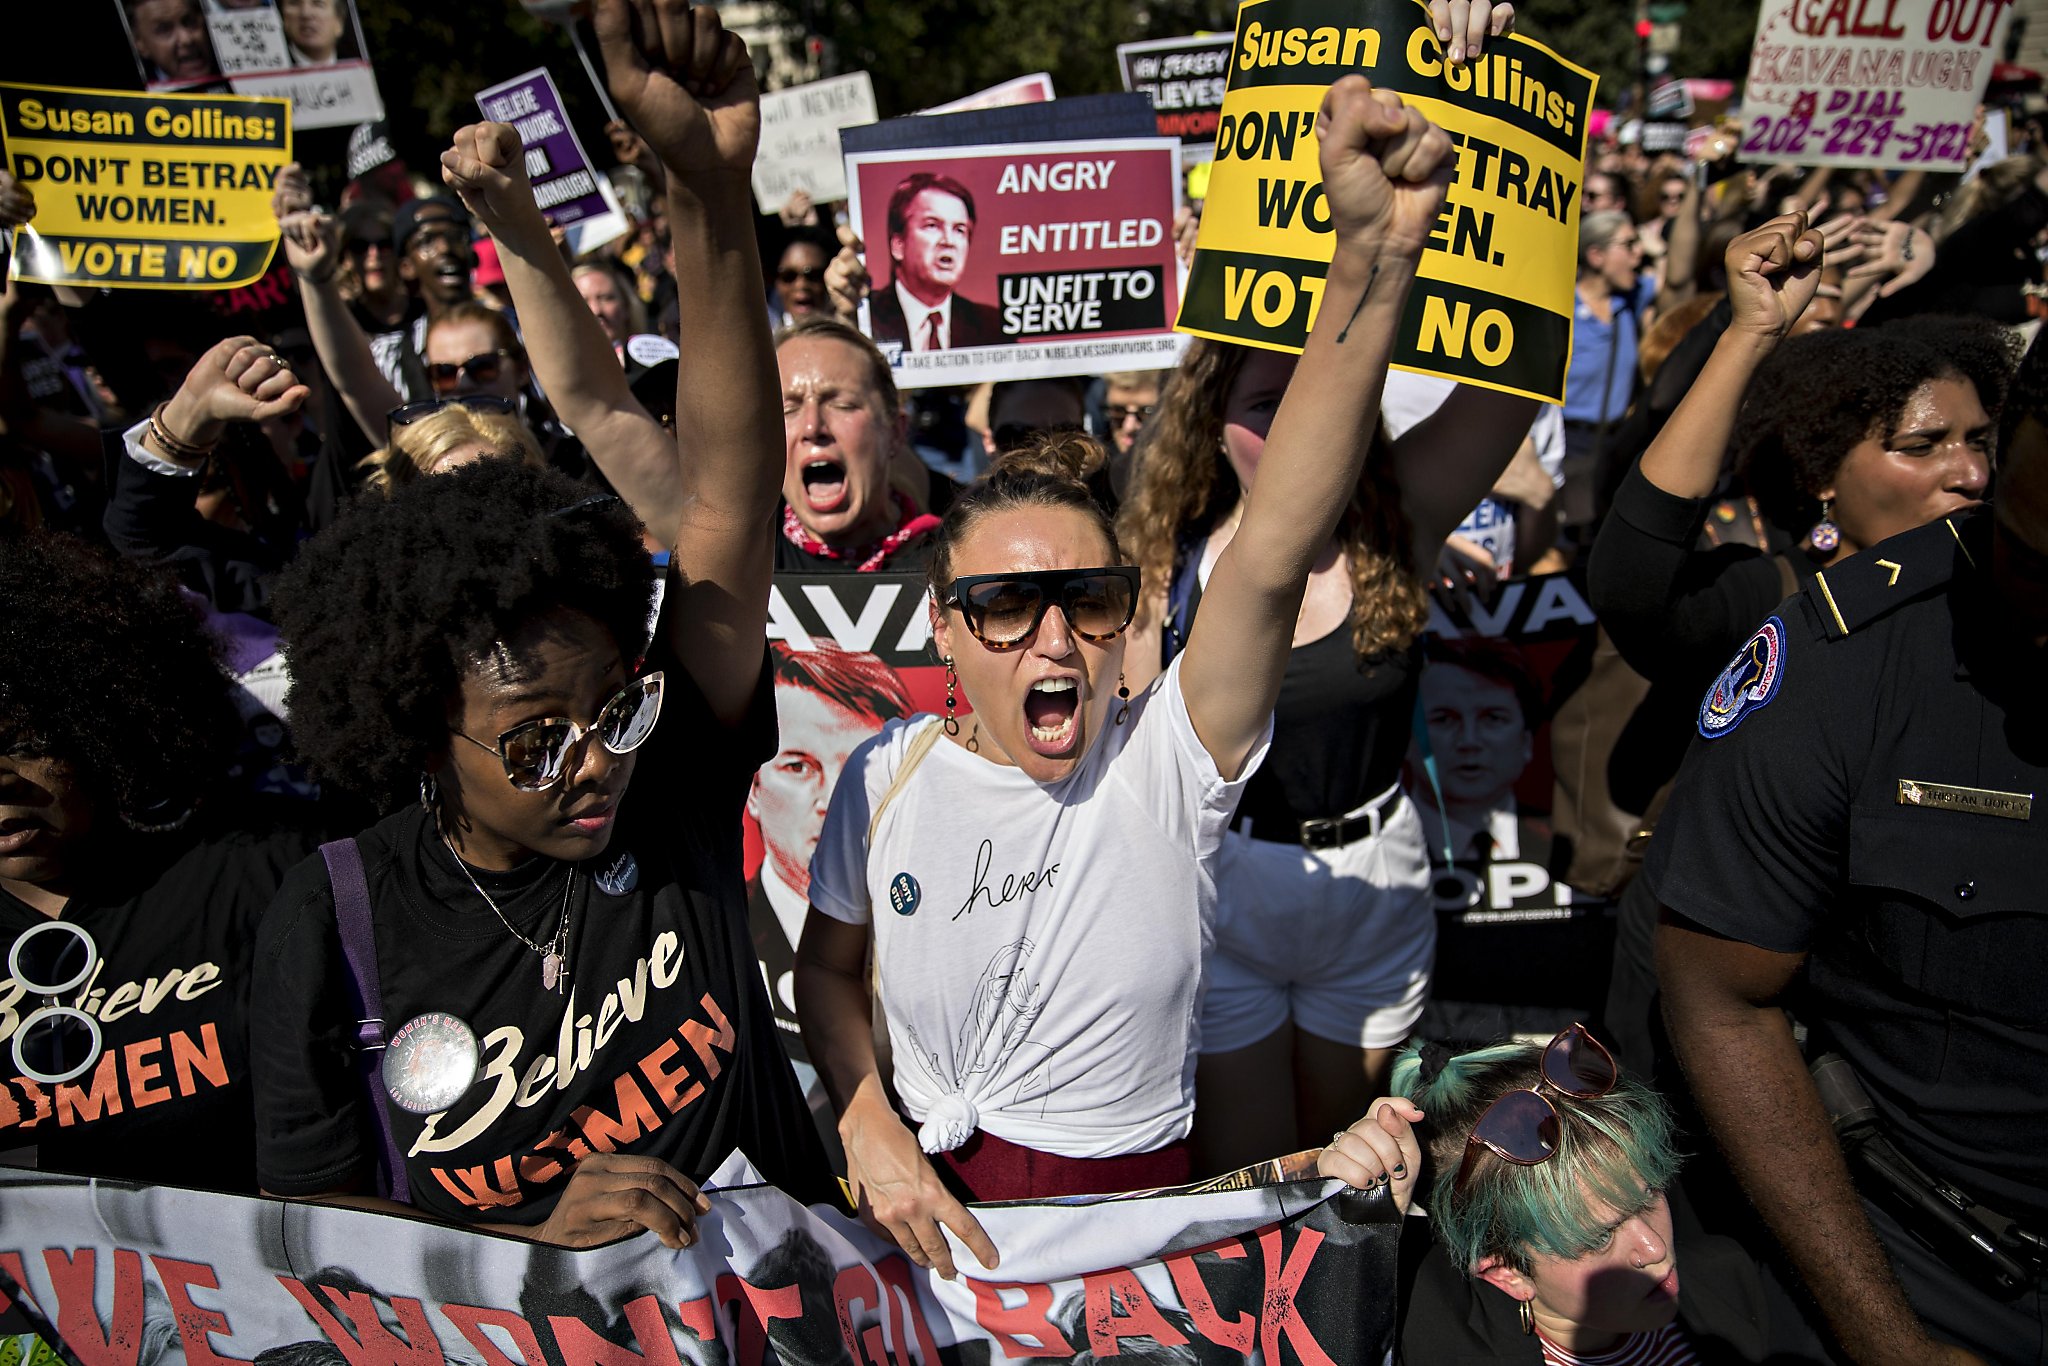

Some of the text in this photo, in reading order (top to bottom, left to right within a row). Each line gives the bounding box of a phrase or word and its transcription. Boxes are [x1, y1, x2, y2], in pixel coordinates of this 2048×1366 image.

[1926, 0, 2013, 47] OUT
[1239, 21, 1381, 72] Susan
[1757, 45, 1982, 92] KAVANAUGH
[1136, 77, 1227, 110] LIEVES
[1825, 89, 1905, 118] DIAL
[18, 98, 276, 141] Susan Collins:
[1744, 115, 1974, 163] 202-224-3121
[13, 154, 283, 189] DON'T BETRAY
[996, 159, 1116, 195] ANGRY
[1215, 111, 1578, 226] DON' ETRAY
[76, 195, 227, 227] WOMEN.
[1258, 177, 1506, 267] WOEN.
[1000, 217, 1163, 256] ENTITLED
[59, 241, 238, 280] VOTE NO
[1002, 270, 1156, 308] UNFIT TO
[1002, 301, 1103, 335] SERVE
[1223, 265, 1514, 367] VOT NO
[934, 353, 970, 368] ACTION
[0, 957, 223, 1043] Blieve
[391, 1014, 440, 1048] WOMEN'S
[407, 931, 685, 1158] Believe
[0, 1022, 230, 1128] OMEN
[430, 992, 737, 1212] WOMEN
[965, 1221, 1340, 1366] BACK
